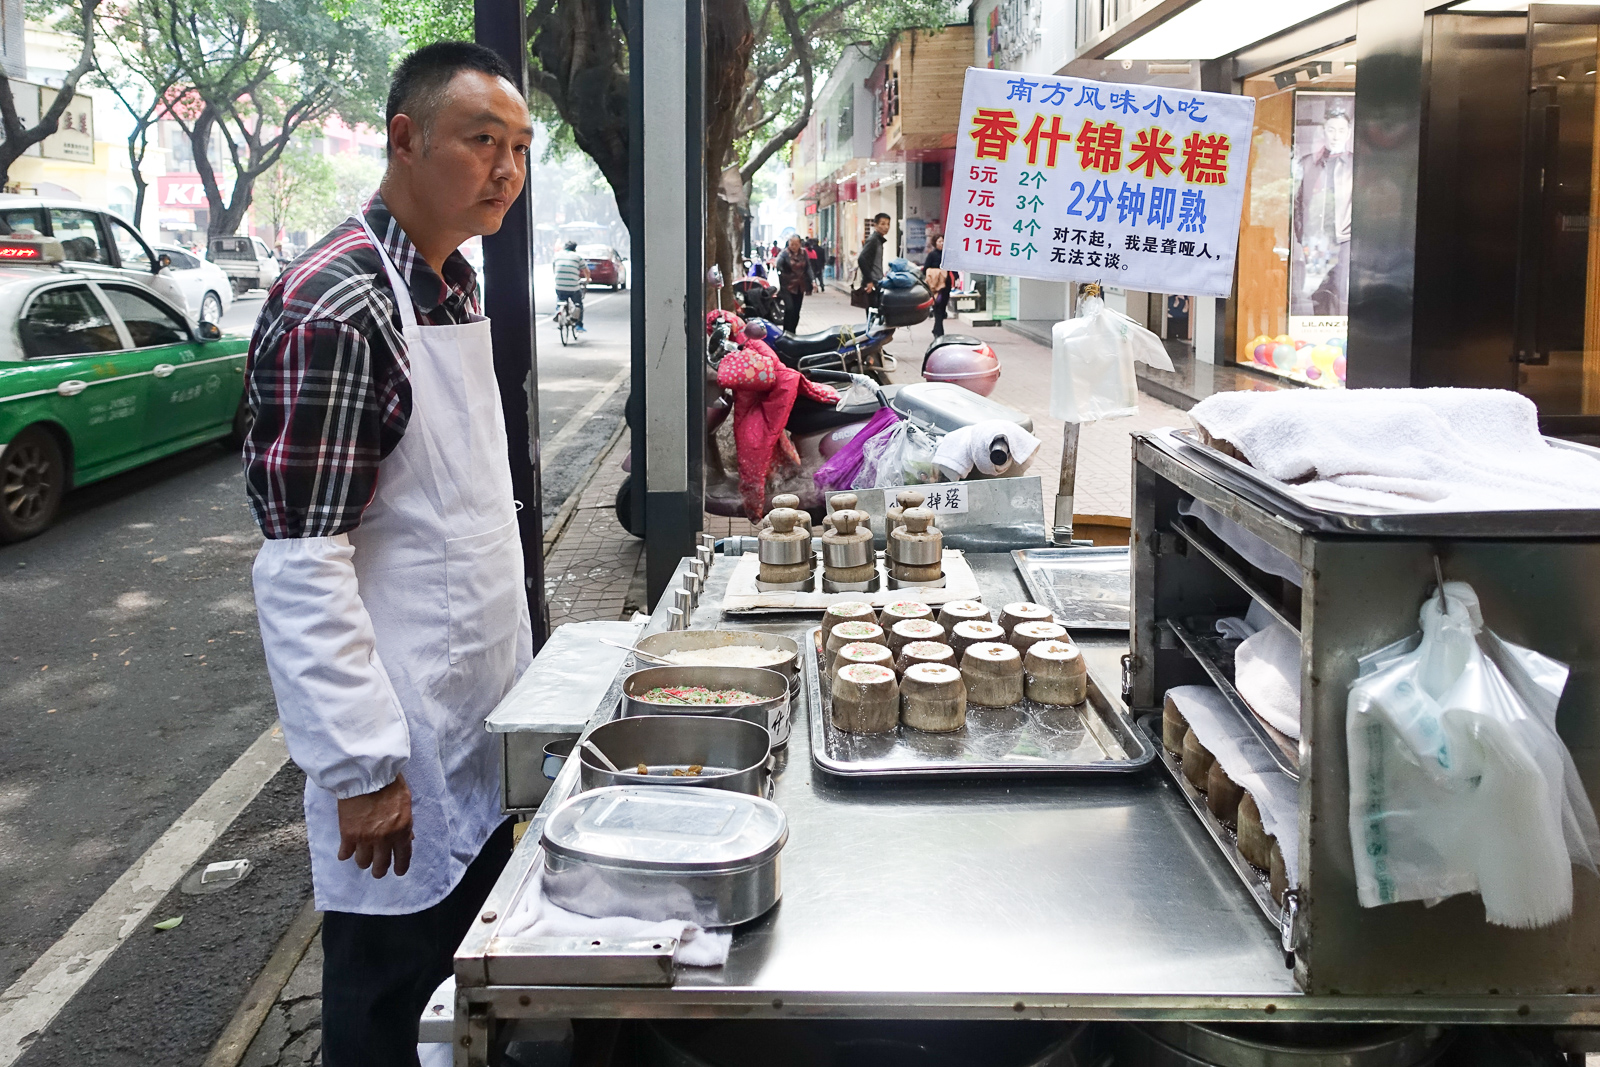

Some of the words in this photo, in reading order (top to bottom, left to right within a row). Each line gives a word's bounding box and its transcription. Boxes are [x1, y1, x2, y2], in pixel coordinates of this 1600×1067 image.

[1006, 77, 1208, 123] 南方风味小吃
[969, 107, 1231, 186] 香什锦米糕
[969, 166, 998, 184] 5元
[1018, 170, 1047, 189] 2个
[164, 183, 225, 205] KF
[967, 189, 995, 207] 7元
[1016, 194, 1044, 213] 3个
[1066, 178, 1207, 234] 2分钟即熟
[963, 213, 992, 231] 9元
[1012, 218, 1041, 237] 4个
[962, 237, 1002, 257] 11元
[1010, 241, 1038, 260] 5个
[1050, 246, 1130, 271] 无法交谈。
